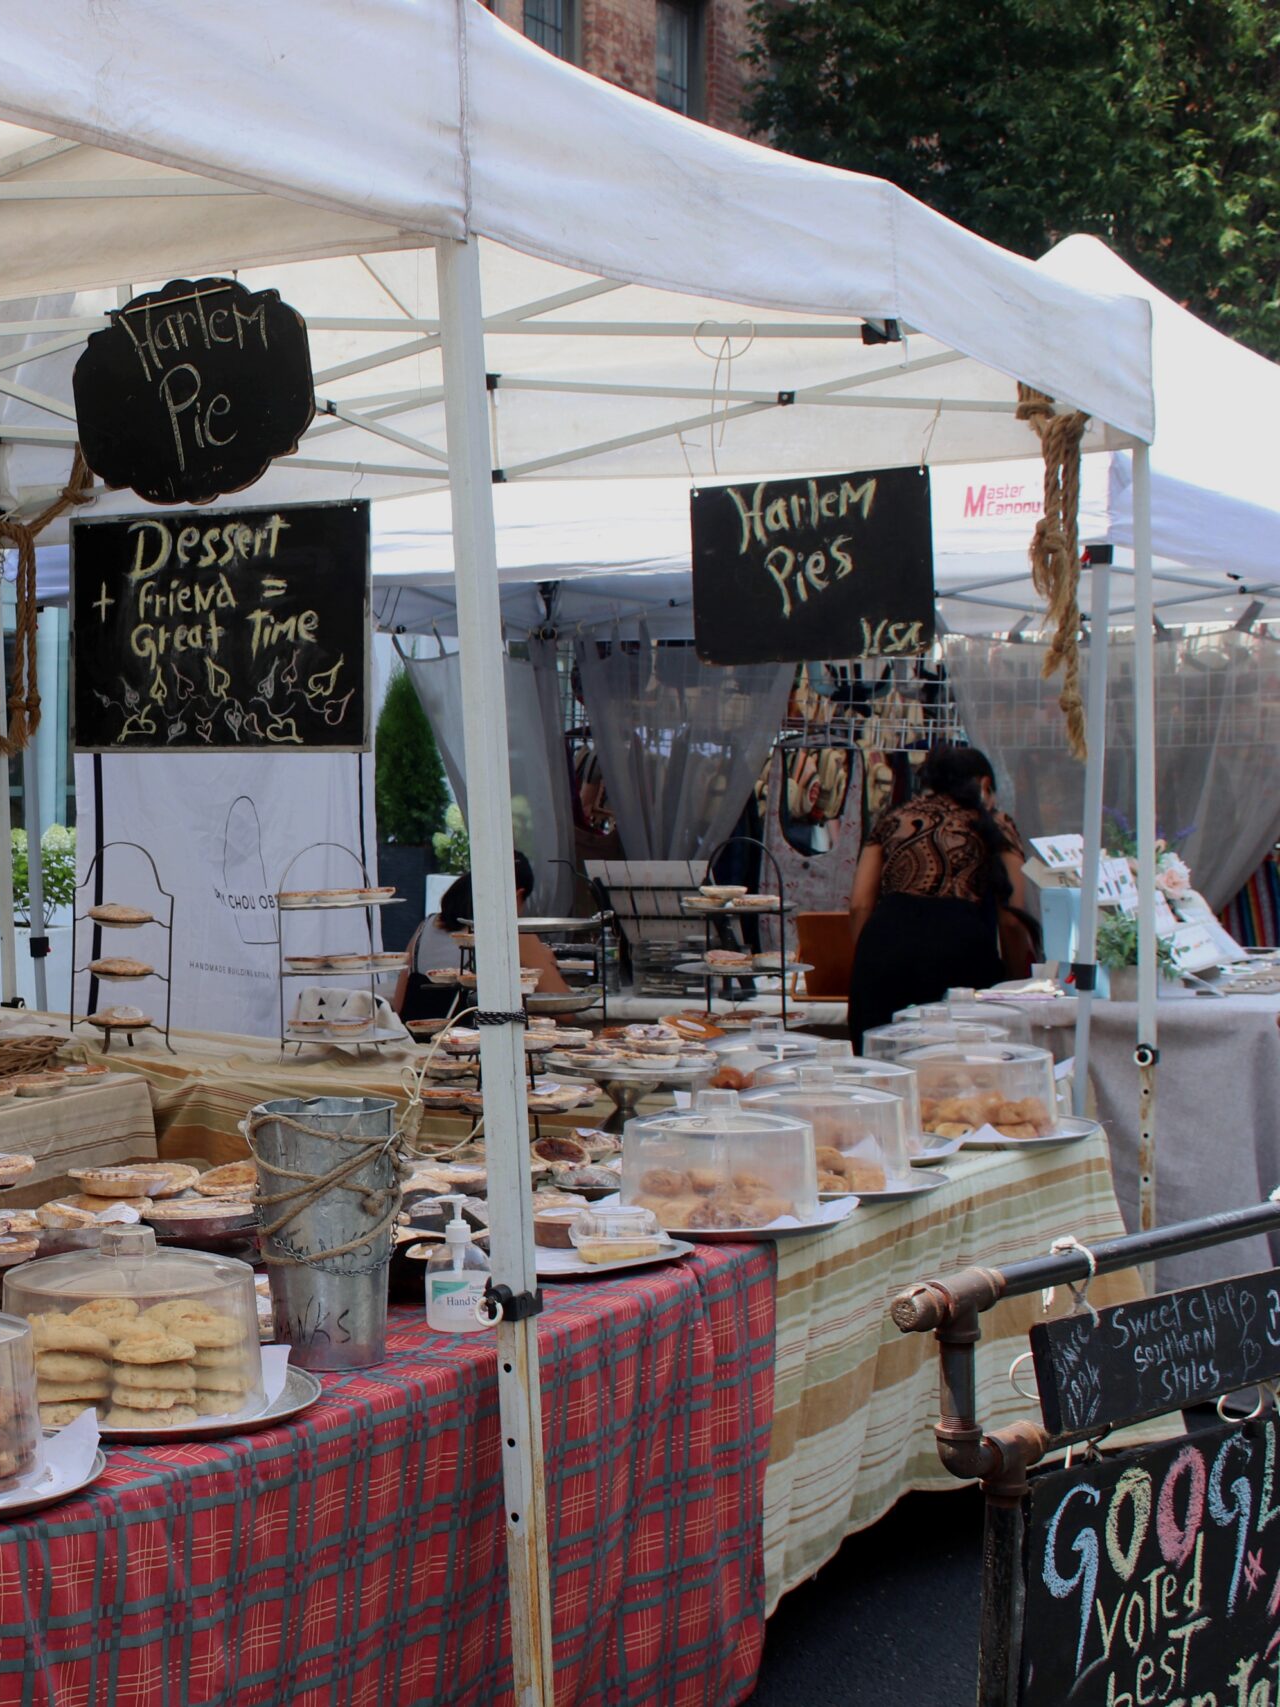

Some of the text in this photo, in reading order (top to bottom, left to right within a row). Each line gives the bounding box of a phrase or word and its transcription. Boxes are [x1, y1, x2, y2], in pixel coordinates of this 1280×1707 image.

[159, 363, 238, 472] Pie
[964, 484, 1025, 518] Master
[126, 514, 291, 580] Dessert
[130, 609, 224, 670] Great
[189, 960, 226, 975] HANDMADE
[446, 1296, 471, 1306] Hand
